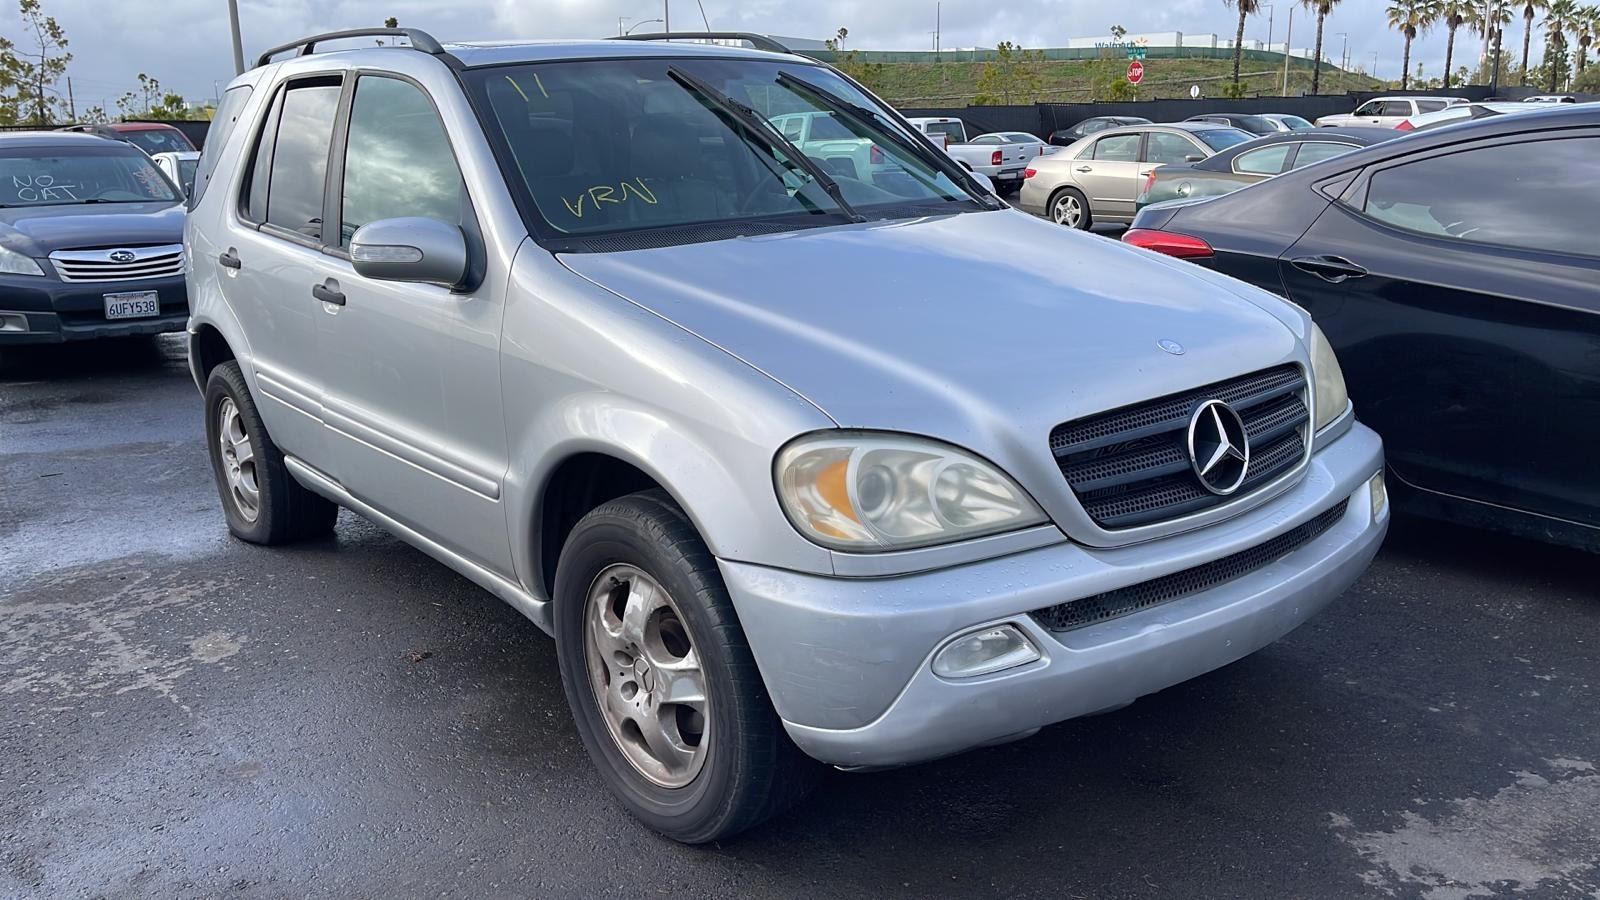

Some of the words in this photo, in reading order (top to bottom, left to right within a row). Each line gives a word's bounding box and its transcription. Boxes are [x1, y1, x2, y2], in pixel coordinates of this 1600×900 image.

[1095, 40, 1136, 48] Walmart
[1128, 68, 1143, 77] STOP
[13, 175, 54, 188] NO
[18, 185, 78, 202] CAT
[560, 177, 658, 218] VRN
[109, 300, 156, 316] 6UFY538
